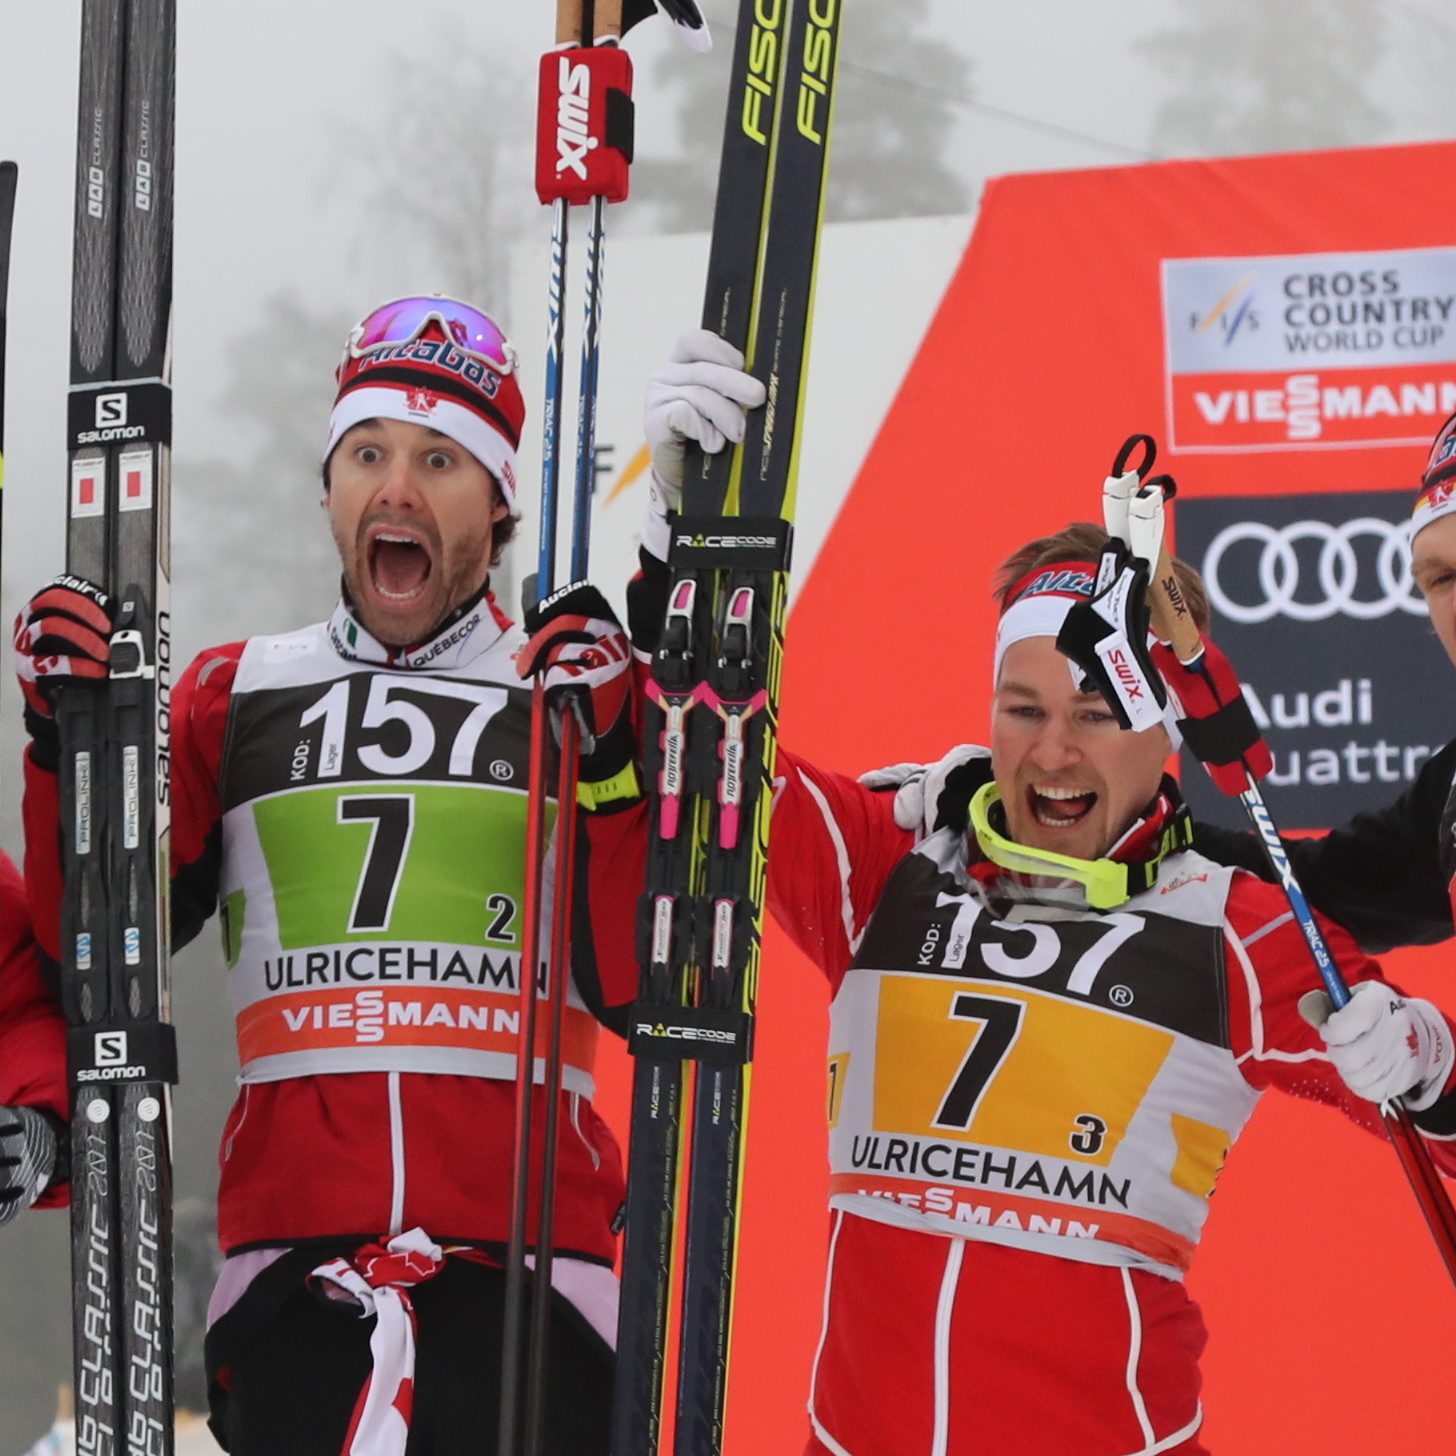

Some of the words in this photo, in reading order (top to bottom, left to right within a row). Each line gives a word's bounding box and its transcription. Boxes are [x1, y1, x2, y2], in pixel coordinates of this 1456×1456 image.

[742, 0, 781, 145] FISC
[797, 0, 838, 145] FISC
[1284, 270, 1401, 300] CROSS
[1284, 294, 1456, 328] COUNTRY
[1285, 327, 1384, 354] WORLD
[1394, 325, 1445, 349] CUP
[55, 575, 95, 595] clair
[412, 612, 482, 668] QUÉBECOR
[299, 673, 509, 779] 157
[290, 738, 311, 781] KOD:
[324, 743, 338, 771] Lager
[336, 793, 416, 934] 7
[485, 891, 517, 943] 2
[935, 891, 1147, 996] 157
[917, 922, 942, 966] KOD:
[281, 989, 521, 1043] VIESSMANN
[930, 988, 1029, 1133] 7
[1070, 1114, 1107, 1155] 3
[851, 1134, 1132, 1211] ULRICEHAMN
